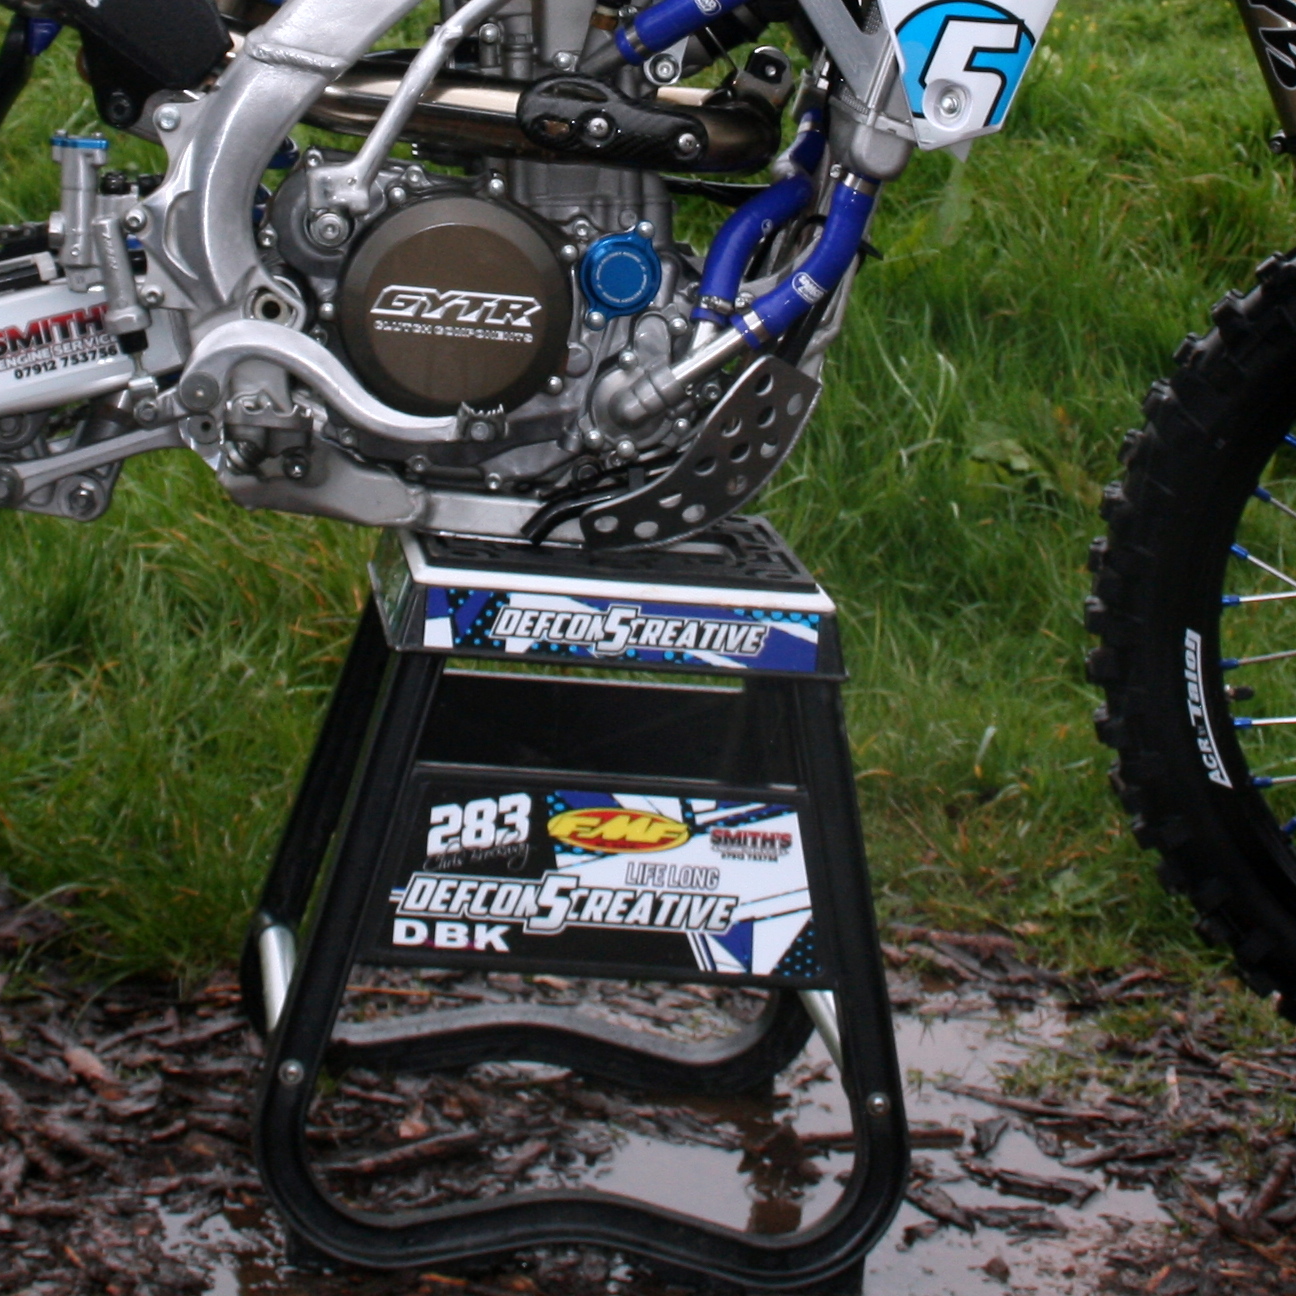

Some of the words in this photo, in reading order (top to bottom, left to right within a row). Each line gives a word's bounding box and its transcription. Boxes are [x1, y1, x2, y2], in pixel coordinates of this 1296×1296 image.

[370, 285, 542, 327] GYTR
[14, 360, 56, 381] 07912
[427, 793, 532, 857] 283
[549, 814, 689, 845] FMF
[710, 828, 792, 849] SMITH'S
[625, 862, 666, 888] LIFE
[668, 865, 720, 891] LONG
